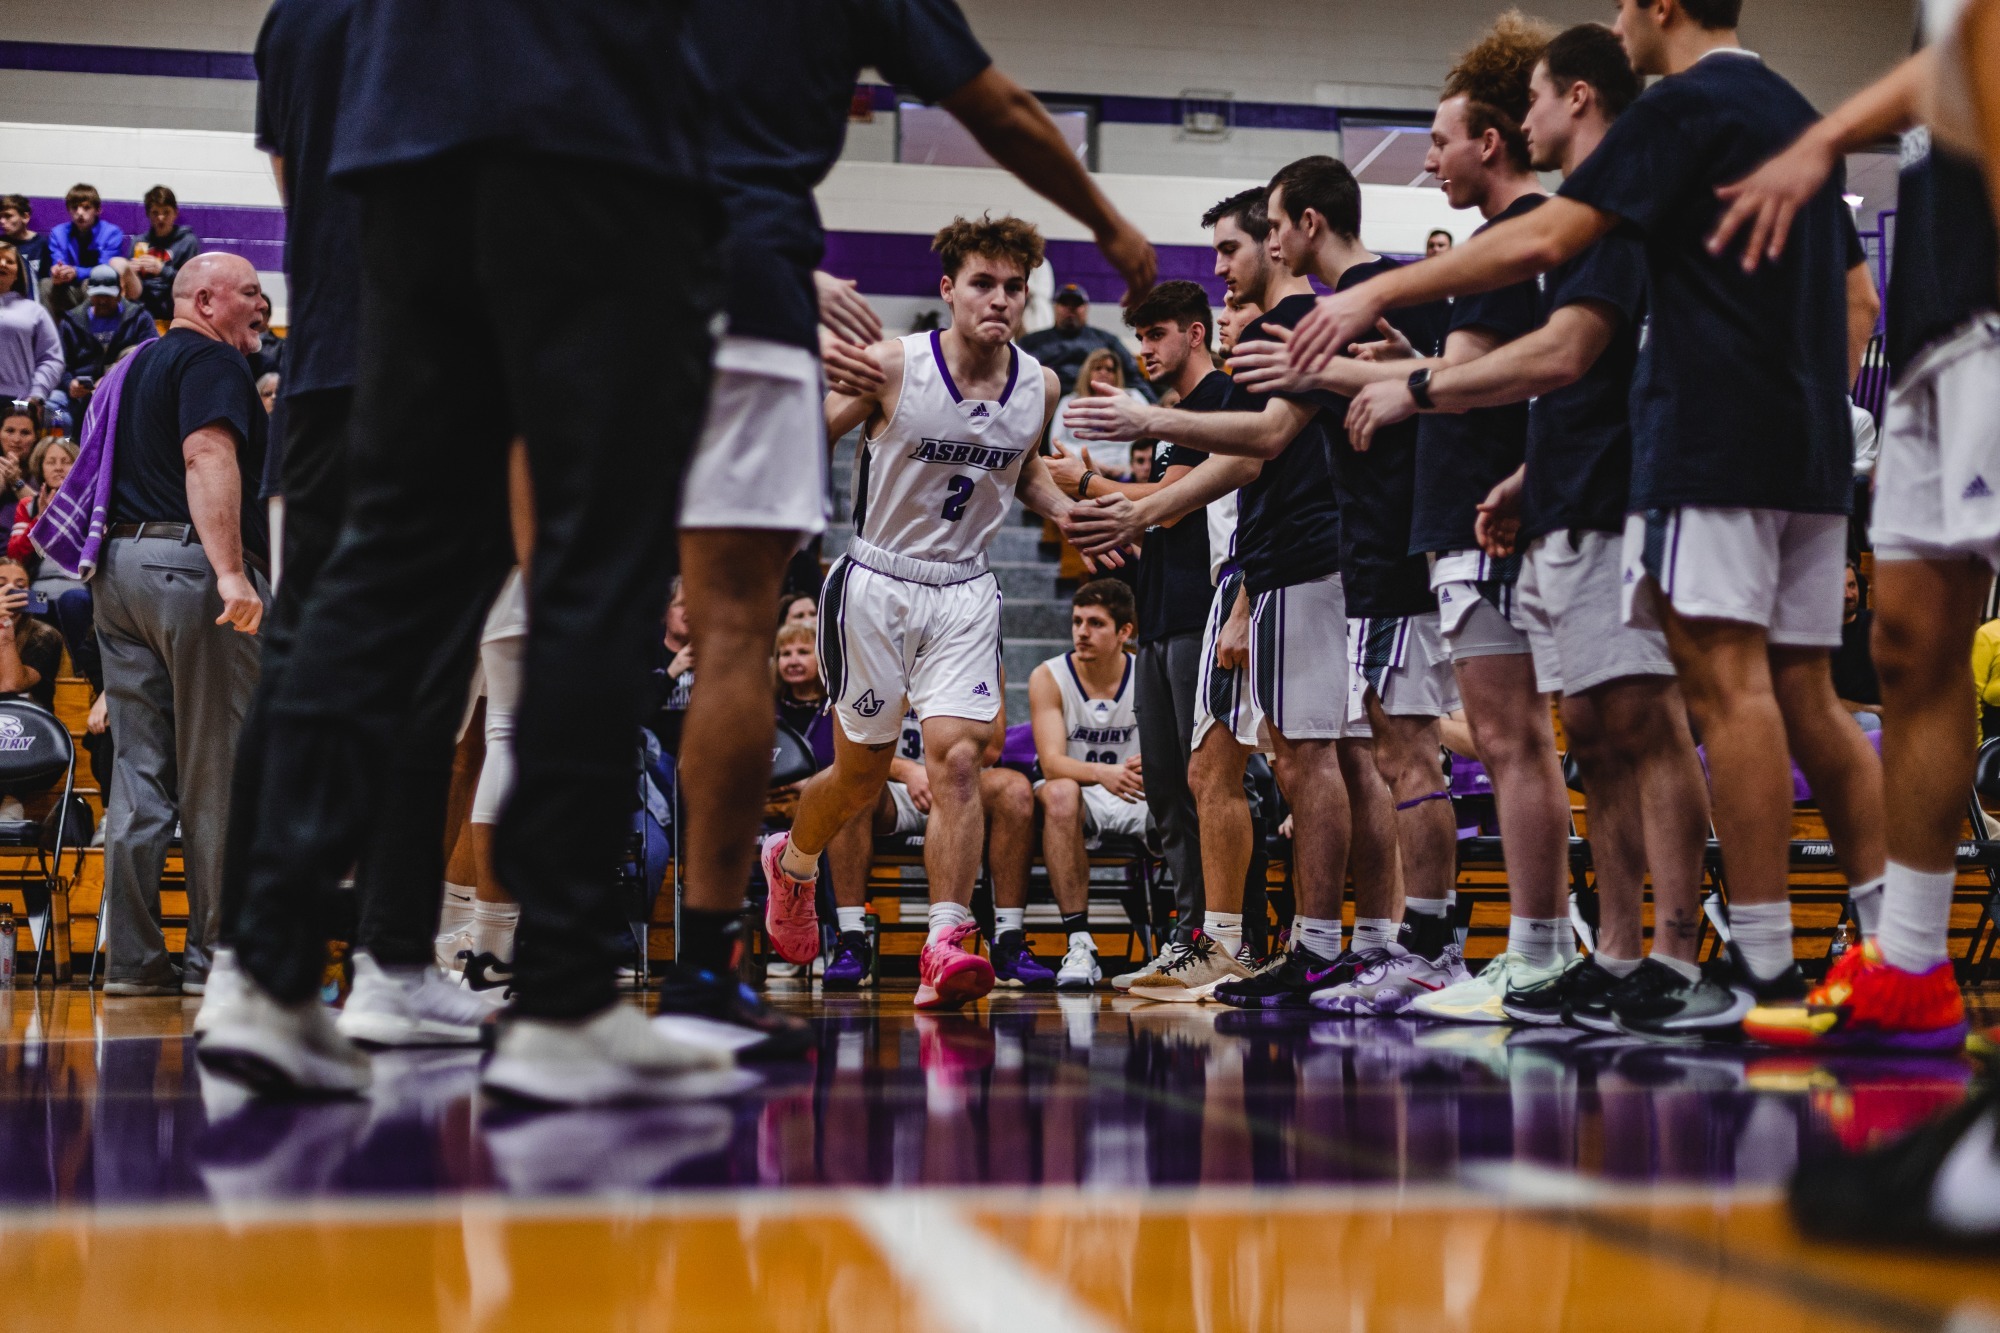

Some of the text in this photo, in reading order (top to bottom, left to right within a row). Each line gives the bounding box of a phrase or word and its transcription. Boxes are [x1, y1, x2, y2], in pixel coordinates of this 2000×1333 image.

[917, 441, 1018, 469] ASBURY
[941, 474, 975, 522] 2
[0, 736, 36, 751] URY
[902, 728, 926, 760] 3
